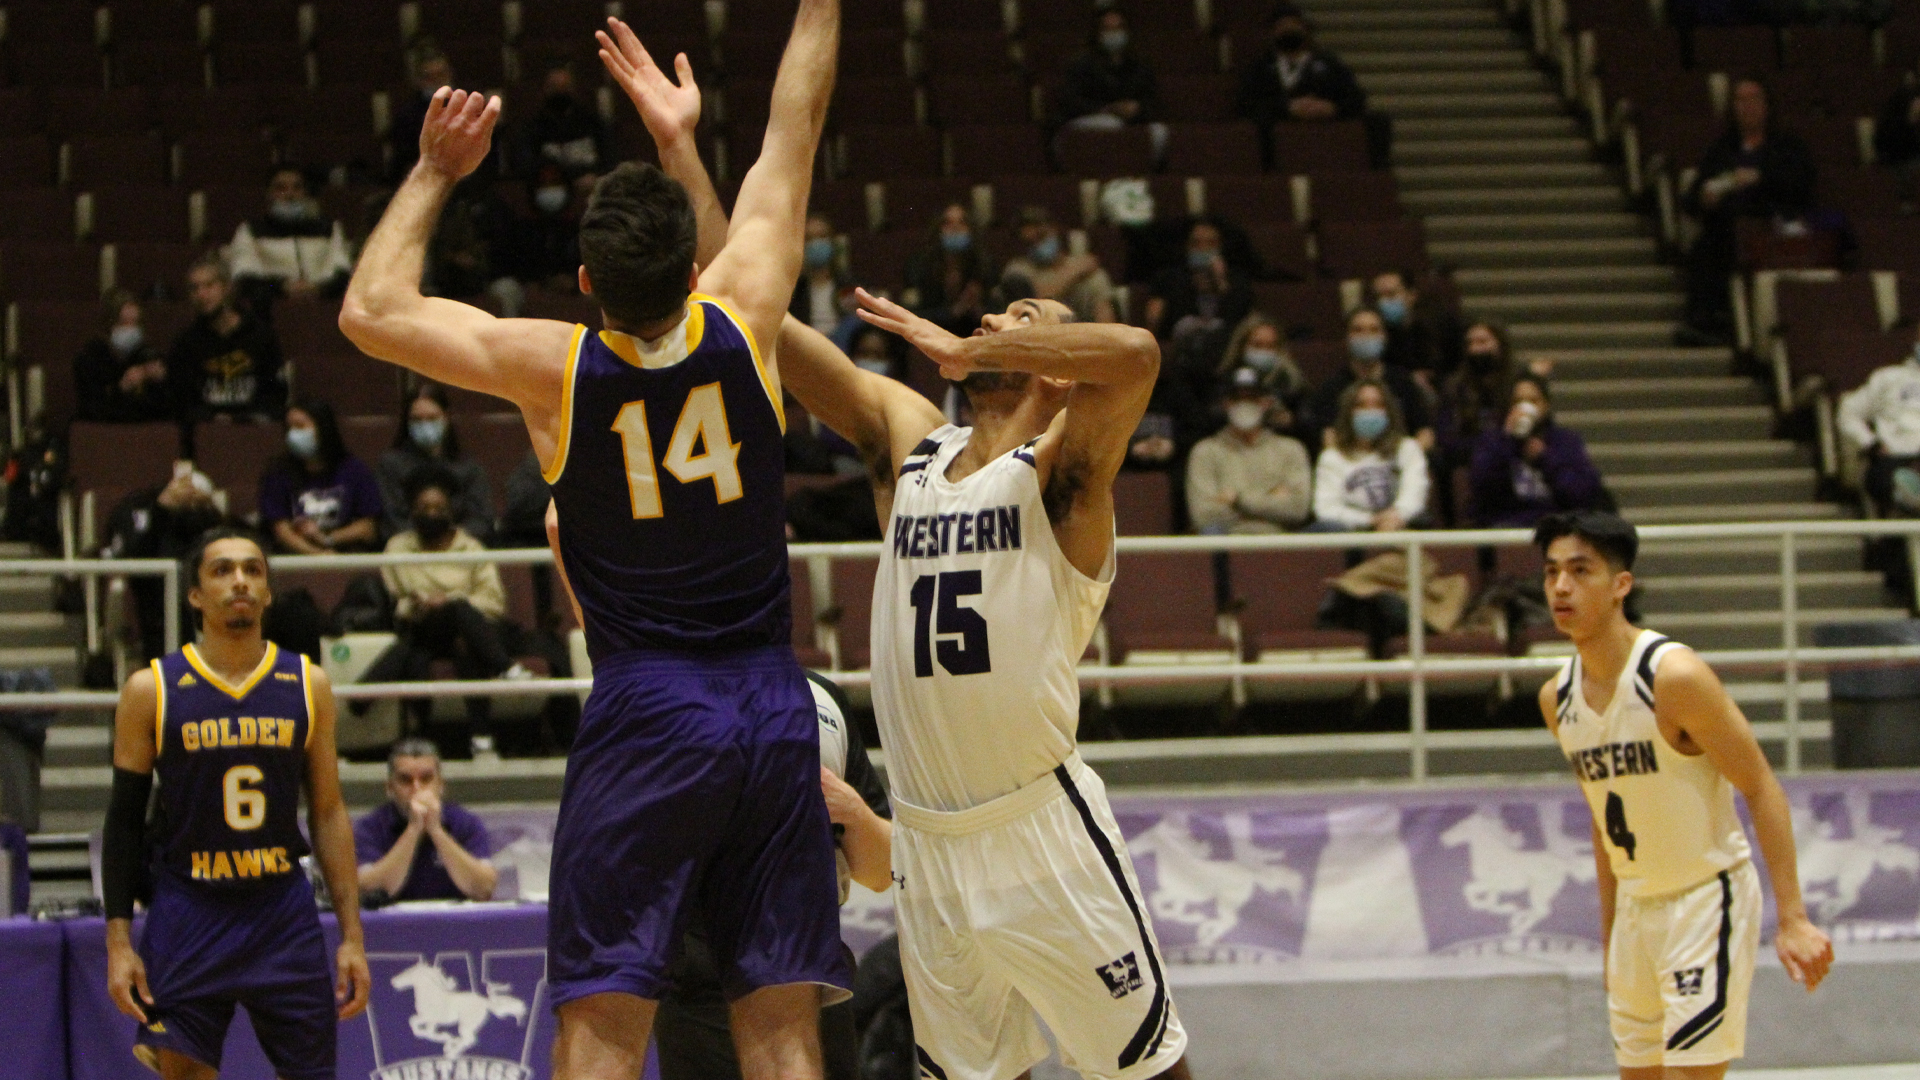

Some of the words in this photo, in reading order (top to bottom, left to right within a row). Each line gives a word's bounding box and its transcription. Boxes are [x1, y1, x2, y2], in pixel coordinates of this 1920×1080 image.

[610, 380, 743, 520] 14
[894, 504, 1022, 559] WESTERN
[910, 569, 991, 678] 15
[181, 716, 295, 751] GOLDEN
[817, 712, 838, 730] UA
[222, 764, 266, 831] 6
[1605, 790, 1636, 861] 4
[191, 847, 291, 880] HAWKS
[380, 1058, 522, 1080] MUSTANGS
